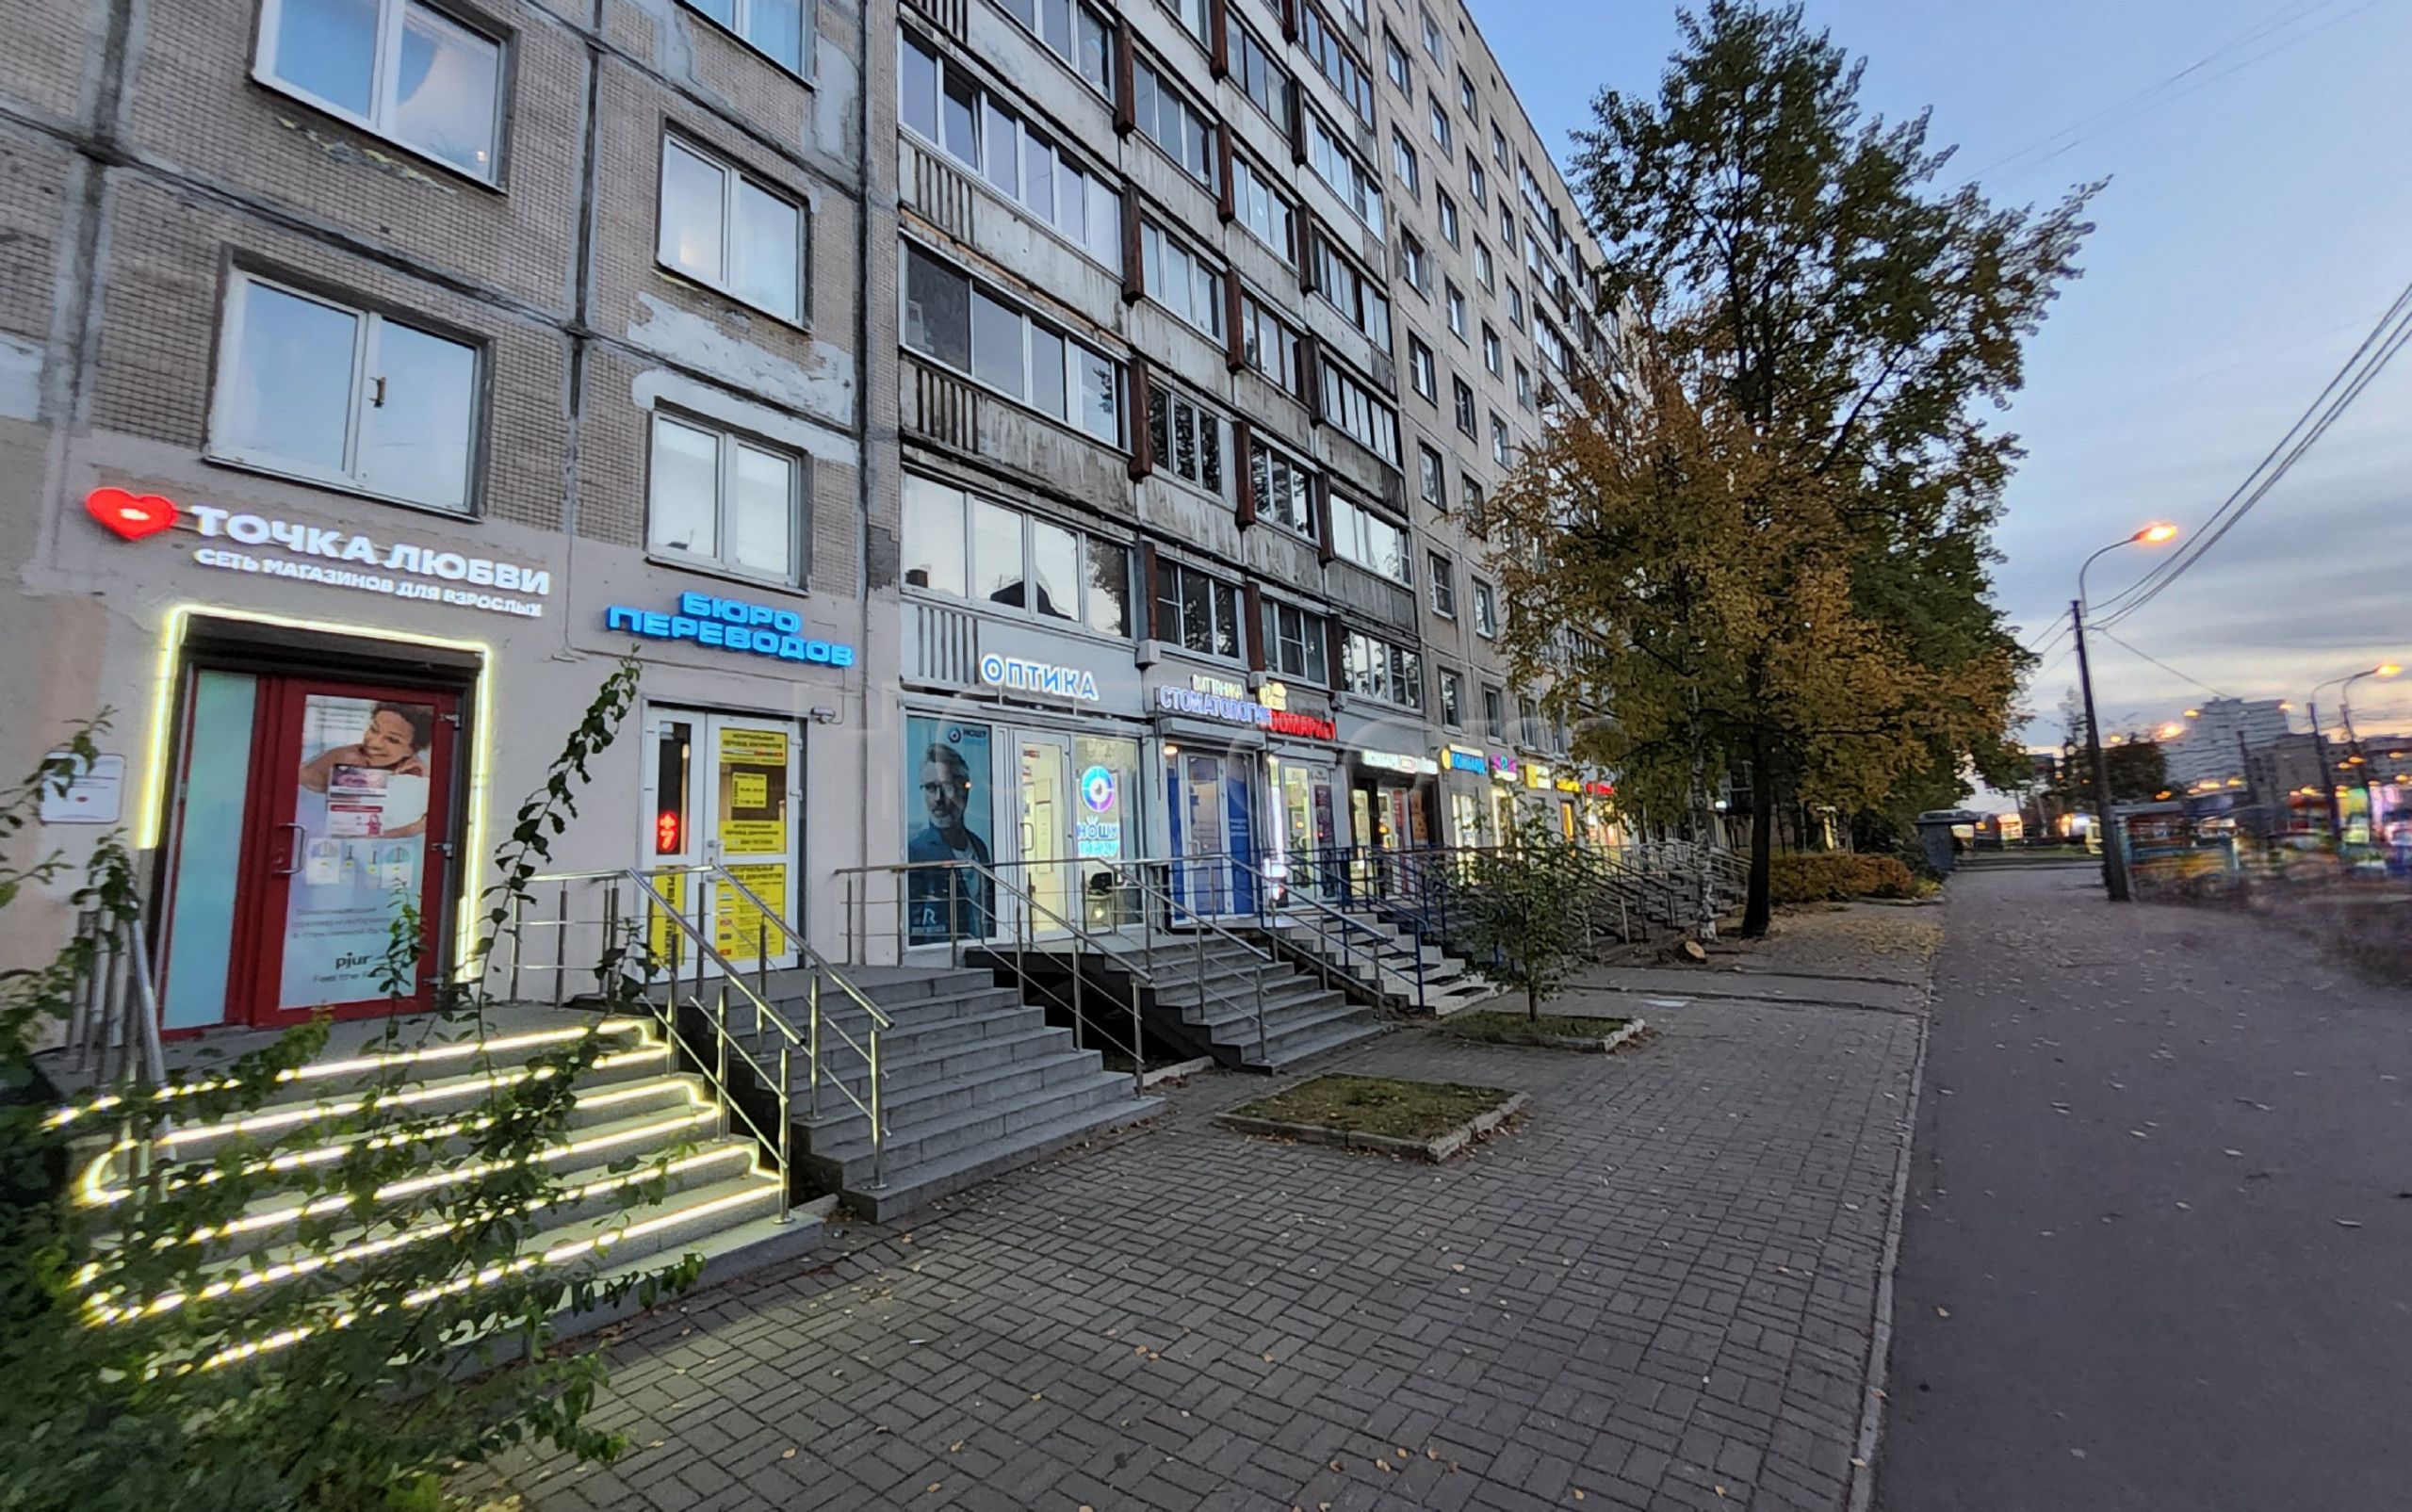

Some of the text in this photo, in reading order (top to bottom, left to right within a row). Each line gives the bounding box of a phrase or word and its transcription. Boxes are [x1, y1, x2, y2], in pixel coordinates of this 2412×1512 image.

[189, 505, 551, 595] ТОЧКА ЛЮБВИ
[194, 548, 543, 617] СЕТЬ МАГАЗИНОВ ДЛЯ ВЗРОСЛЫХ
[606, 605, 855, 666] ПЕРЕВОДОВ
[680, 591, 802, 633] БЮРО
[981, 654, 1100, 701] ОПТИКА
[335, 951, 373, 970] pjur
